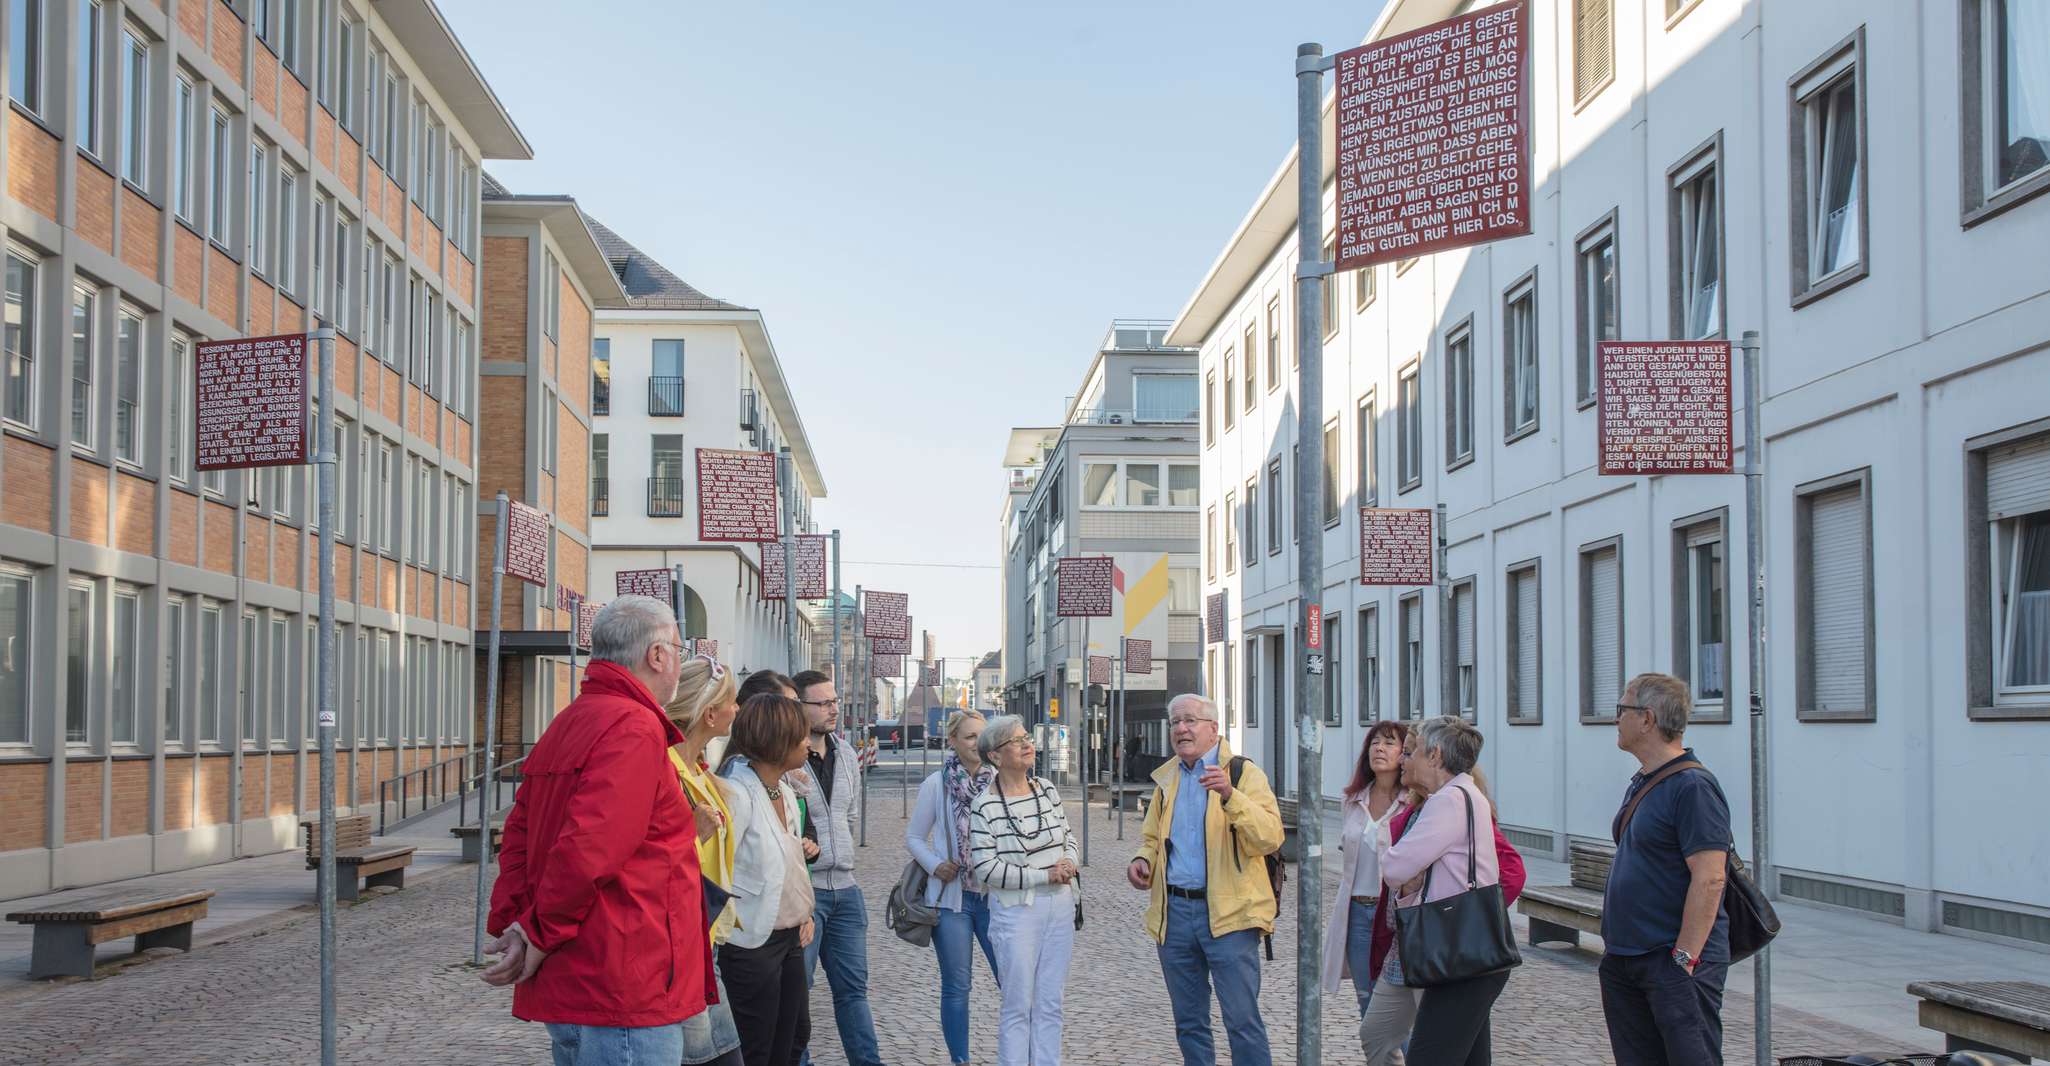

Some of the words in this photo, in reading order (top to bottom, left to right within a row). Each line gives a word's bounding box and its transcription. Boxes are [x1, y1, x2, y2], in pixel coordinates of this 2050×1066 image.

[1341, 56, 1355, 71] ES
[1359, 46, 1385, 65] GIBT
[1389, 21, 1470, 55] UNIVERSELLE
[1475, 6, 1517, 30] GESET
[1341, 69, 1354, 84] ZE
[1358, 65, 1368, 77] IN
[1372, 56, 1396, 73] DER
[1400, 41, 1445, 65] PHYSIK.
[1451, 33, 1471, 50] DIE
[1475, 20, 1517, 43] GELTE
[1341, 85, 1348, 97] N
[1351, 73, 1372, 93] FÜR
[1376, 66, 1408, 86] ALLE.
[1413, 56, 1440, 75] GIBT
[1444, 50, 1460, 66] ES
[1464, 41, 1493, 60] EINE
[1498, 35, 1517, 51] AN
[1341, 72, 1434, 109] GEMESSENHEIT?
[1440, 64, 1458, 81] IST
[1464, 58, 1479, 74] ES
[1484, 46, 1516, 69] MÖG
[1341, 106, 1366, 125] LICH,
[1370, 95, 1392, 114] FÜR
[1397, 88, 1425, 107] ALLE
[1430, 77, 1465, 98] EINEN
[1469, 61, 1516, 87] WÜNSC
[1341, 114, 1384, 136] HBAREN
[1390, 97, 1443, 123] ZUSTAND
[1448, 92, 1463, 107] ZU
[1469, 78, 1515, 102] ERREIC
[1341, 132, 1367, 150] HEN?
[1371, 123, 1398, 141] SICH
[1401, 111, 1444, 133] ETWAS
[1446, 99, 1490, 121] GEBEN
[1494, 93, 1516, 110] HEI
[1341, 147, 1362, 165] SST,
[1365, 142, 1380, 157] ES
[1383, 125, 1447, 152] IRGENDWO
[1450, 109, 1508, 135] NEHMEN.
[1512, 108, 1516, 120] I
[1341, 163, 1354, 177] CH
[1357, 145, 1413, 172] WÜNSCHE
[1417, 141, 1440, 159] MIR,
[1444, 131, 1475, 150] DASS
[1480, 122, 1516, 142] ABEN
[1341, 176, 1357, 192] DS,
[1360, 166, 1394, 185] WENN
[1397, 160, 1417, 176] ICH
[1420, 155, 1436, 171] ZU
[1440, 146, 1472, 165] BETT
[1475, 136, 1517, 159] GEHE,
[1341, 183, 1385, 203] JEMAND
[1387, 175, 1414, 192] EINE
[1416, 156, 1495, 185] GESCHICHTE
[1498, 151, 1517, 167] ER
[1341, 196, 1373, 217] ZÄHLT
[1377, 192, 1401, 209] UND
[1405, 186, 1425, 202] MIR
[1430, 175, 1462, 196] ÜBER
[1467, 171, 1493, 188] DEN
[1498, 166, 1517, 182] KO
[1341, 218, 1353, 230] PF
[1357, 205, 1395, 227] FÄHRT.
[1399, 199, 1431, 217] ABER
[1435, 189, 1478, 209] SAGEN
[1482, 183, 1503, 200] SIE
[1508, 181, 1517, 194] D
[1341, 231, 1355, 245] AS
[1360, 219, 1406, 242] KEINEM,
[1412, 211, 1445, 229] DANN
[1451, 205, 1472, 220] BIN
[1478, 199, 1500, 215] ICH
[1507, 196, 1518, 209] M
[1342, 241, 1374, 258] EINEN
[1379, 231, 1418, 251] GUTEN
[1424, 225, 1447, 241] RUF
[1453, 217, 1482, 235] HIER
[1488, 210, 1518, 228] LOS.
[1604, 369, 1646, 378] HAUSTÜR
[1650, 368, 1726, 377] GEGENÜBERSTAN
[1676, 376, 1711, 385] LÜGEN?
[1681, 393, 1711, 402] GLÜCK
[1605, 419, 1629, 427] RTEN
[1698, 417, 1727, 426] LÜGEN
[1605, 452, 1632, 460] IESEM
[1636, 452, 1662, 460] FALLE
